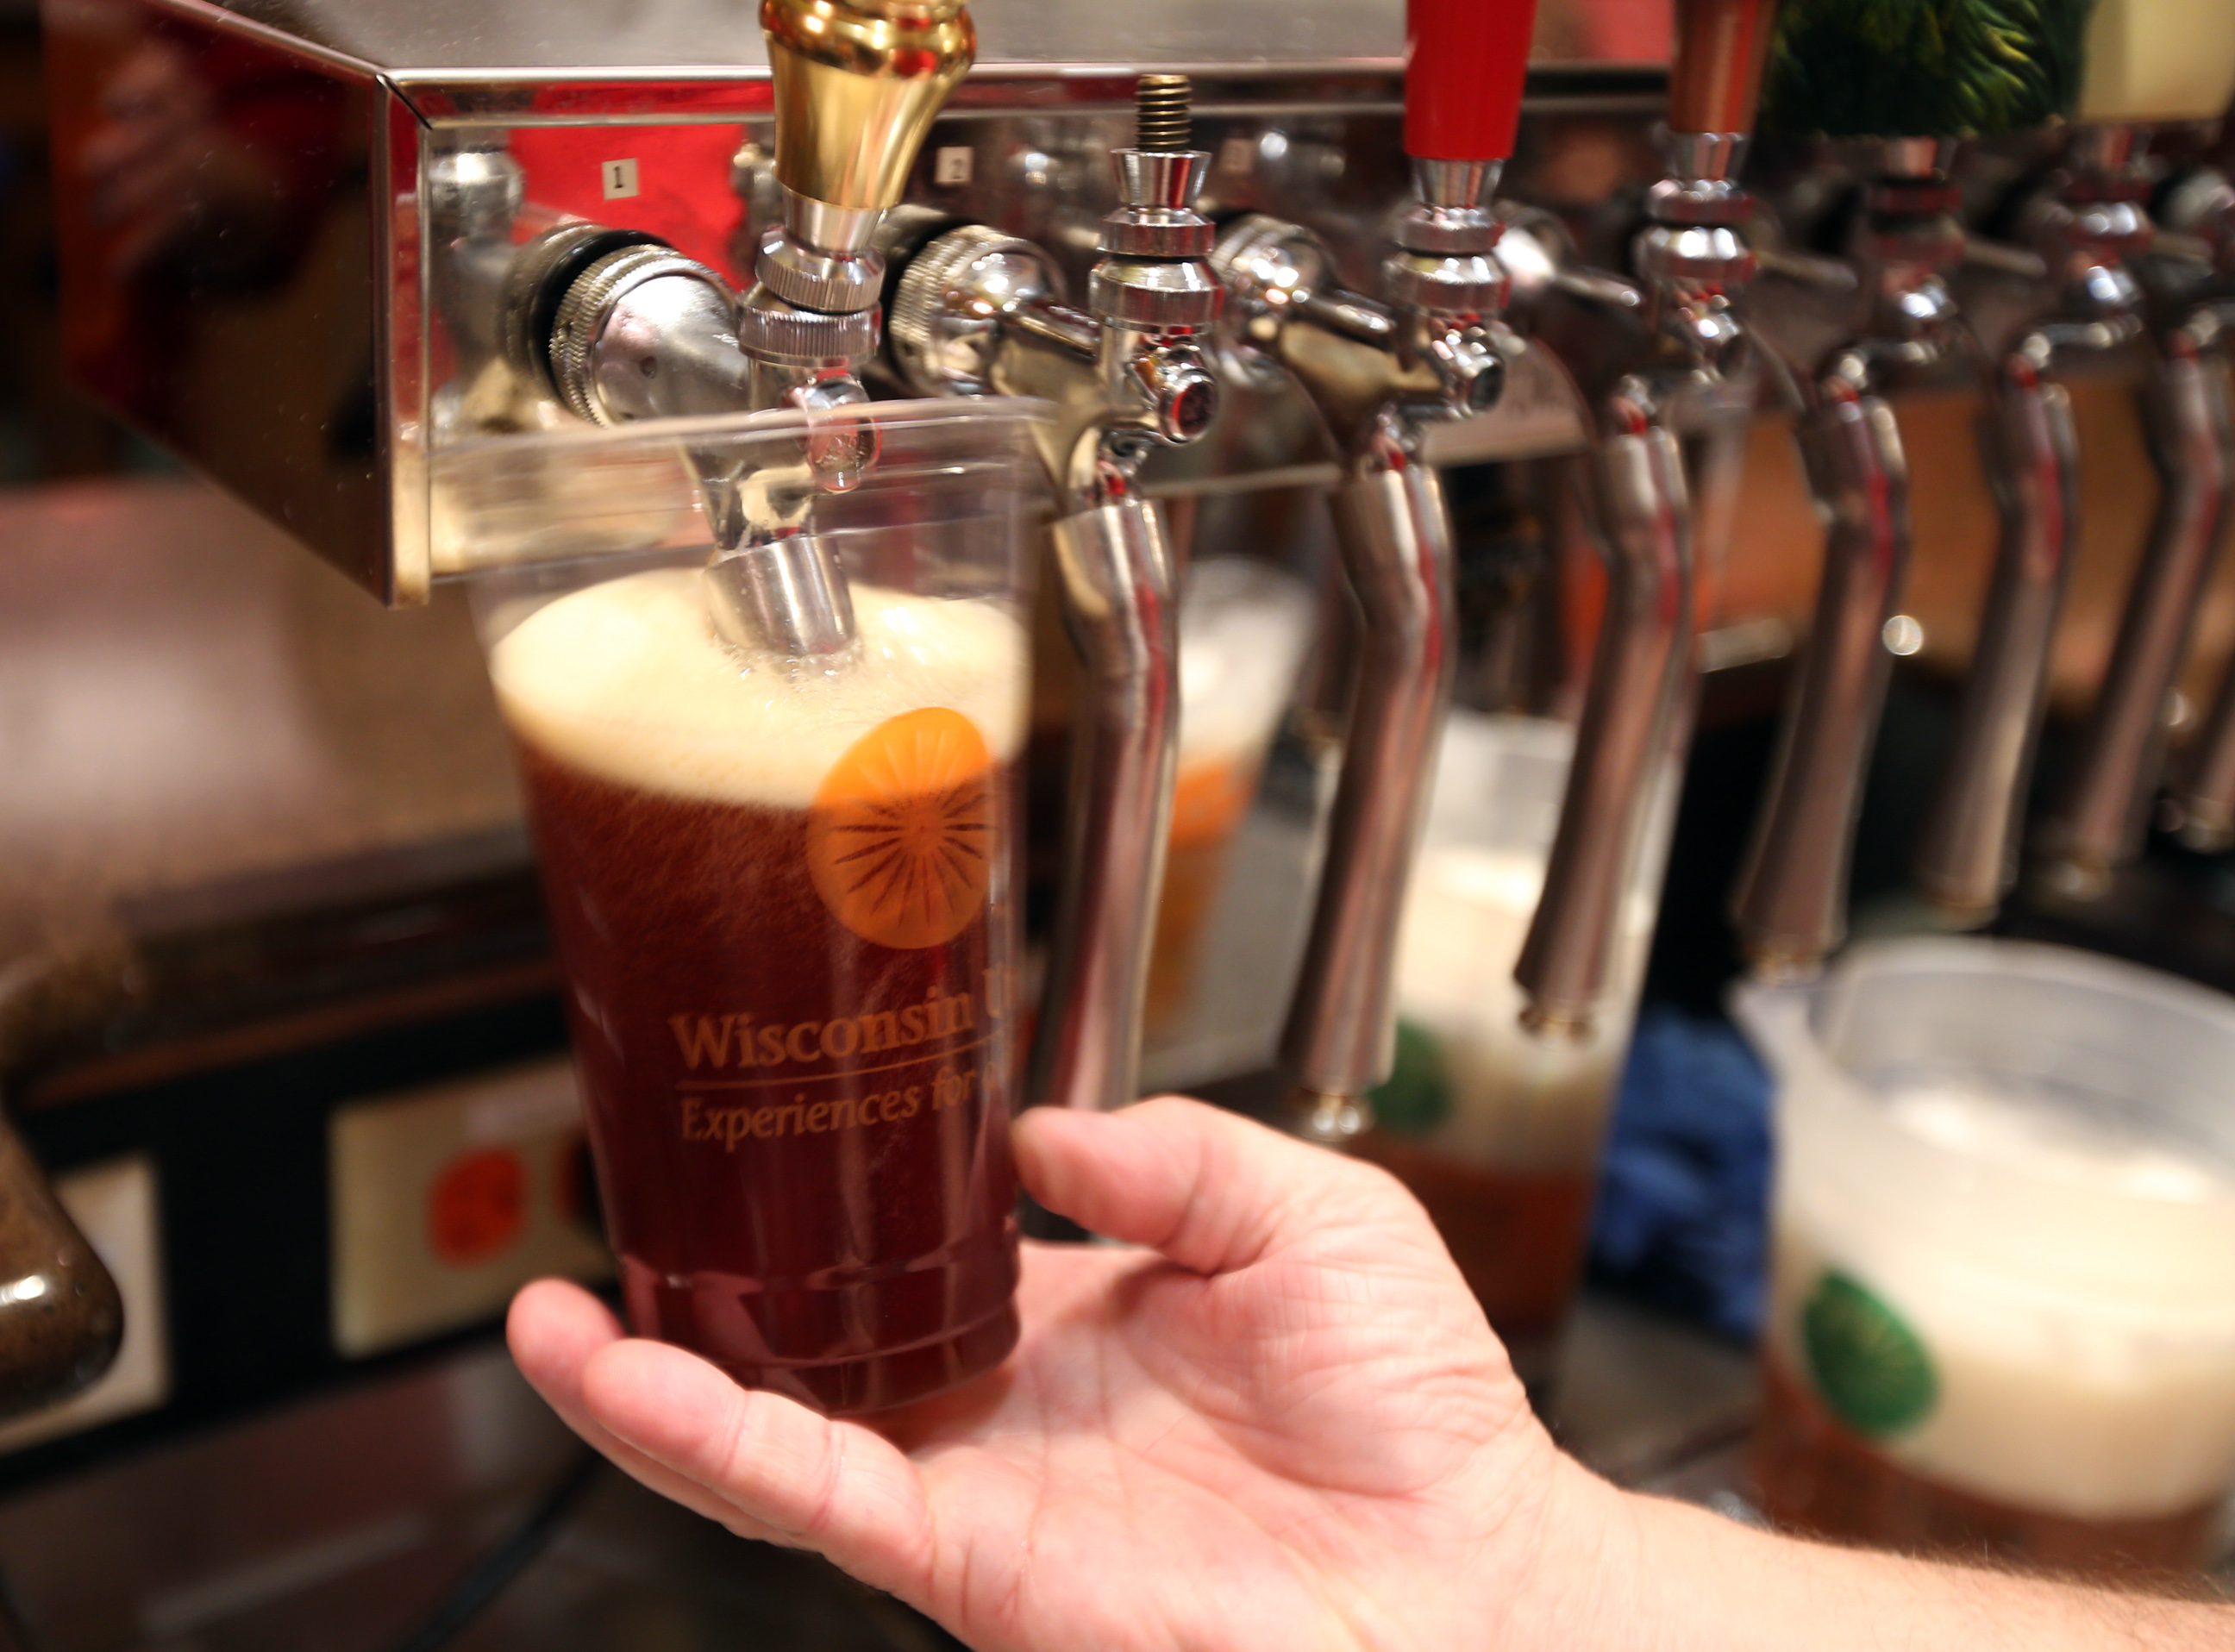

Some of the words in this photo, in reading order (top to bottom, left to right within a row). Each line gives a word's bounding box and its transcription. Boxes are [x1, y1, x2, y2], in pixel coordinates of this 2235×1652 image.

[613, 165, 623, 189] 1
[668, 986, 975, 1069] Wisconsin
[680, 1085, 921, 1154] Experiences
[930, 1066, 976, 1111] for
